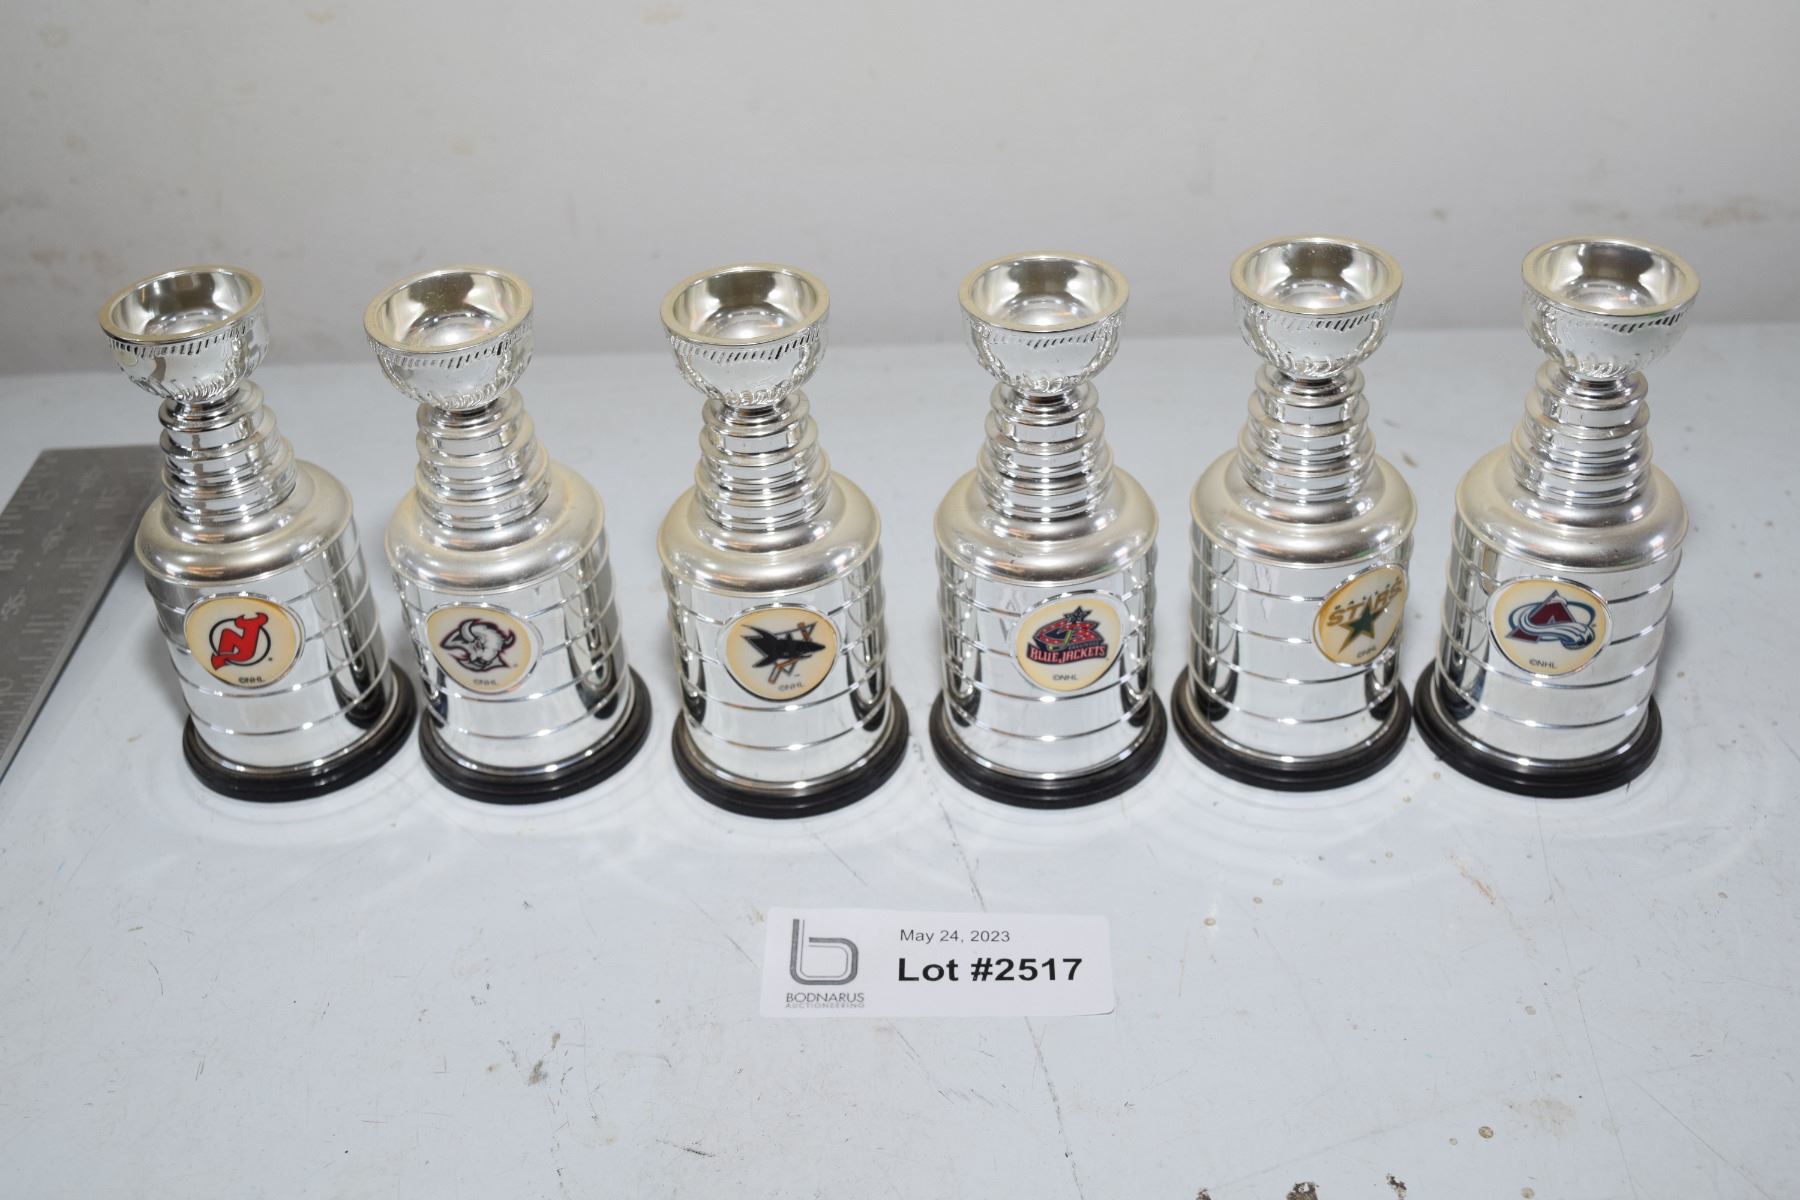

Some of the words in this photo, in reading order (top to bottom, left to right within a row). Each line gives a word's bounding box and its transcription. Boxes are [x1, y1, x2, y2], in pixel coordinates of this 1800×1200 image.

[1029, 646, 1059, 663] BLUE
[1059, 645, 1106, 663] JACKETS
[900, 929, 934, 944] May
[939, 930, 964, 943] 24,
[970, 930, 1011, 942] 2023
[898, 957, 959, 981] Lot
[970, 957, 1083, 981] #2517
[786, 992, 865, 1003] BODNARUS
